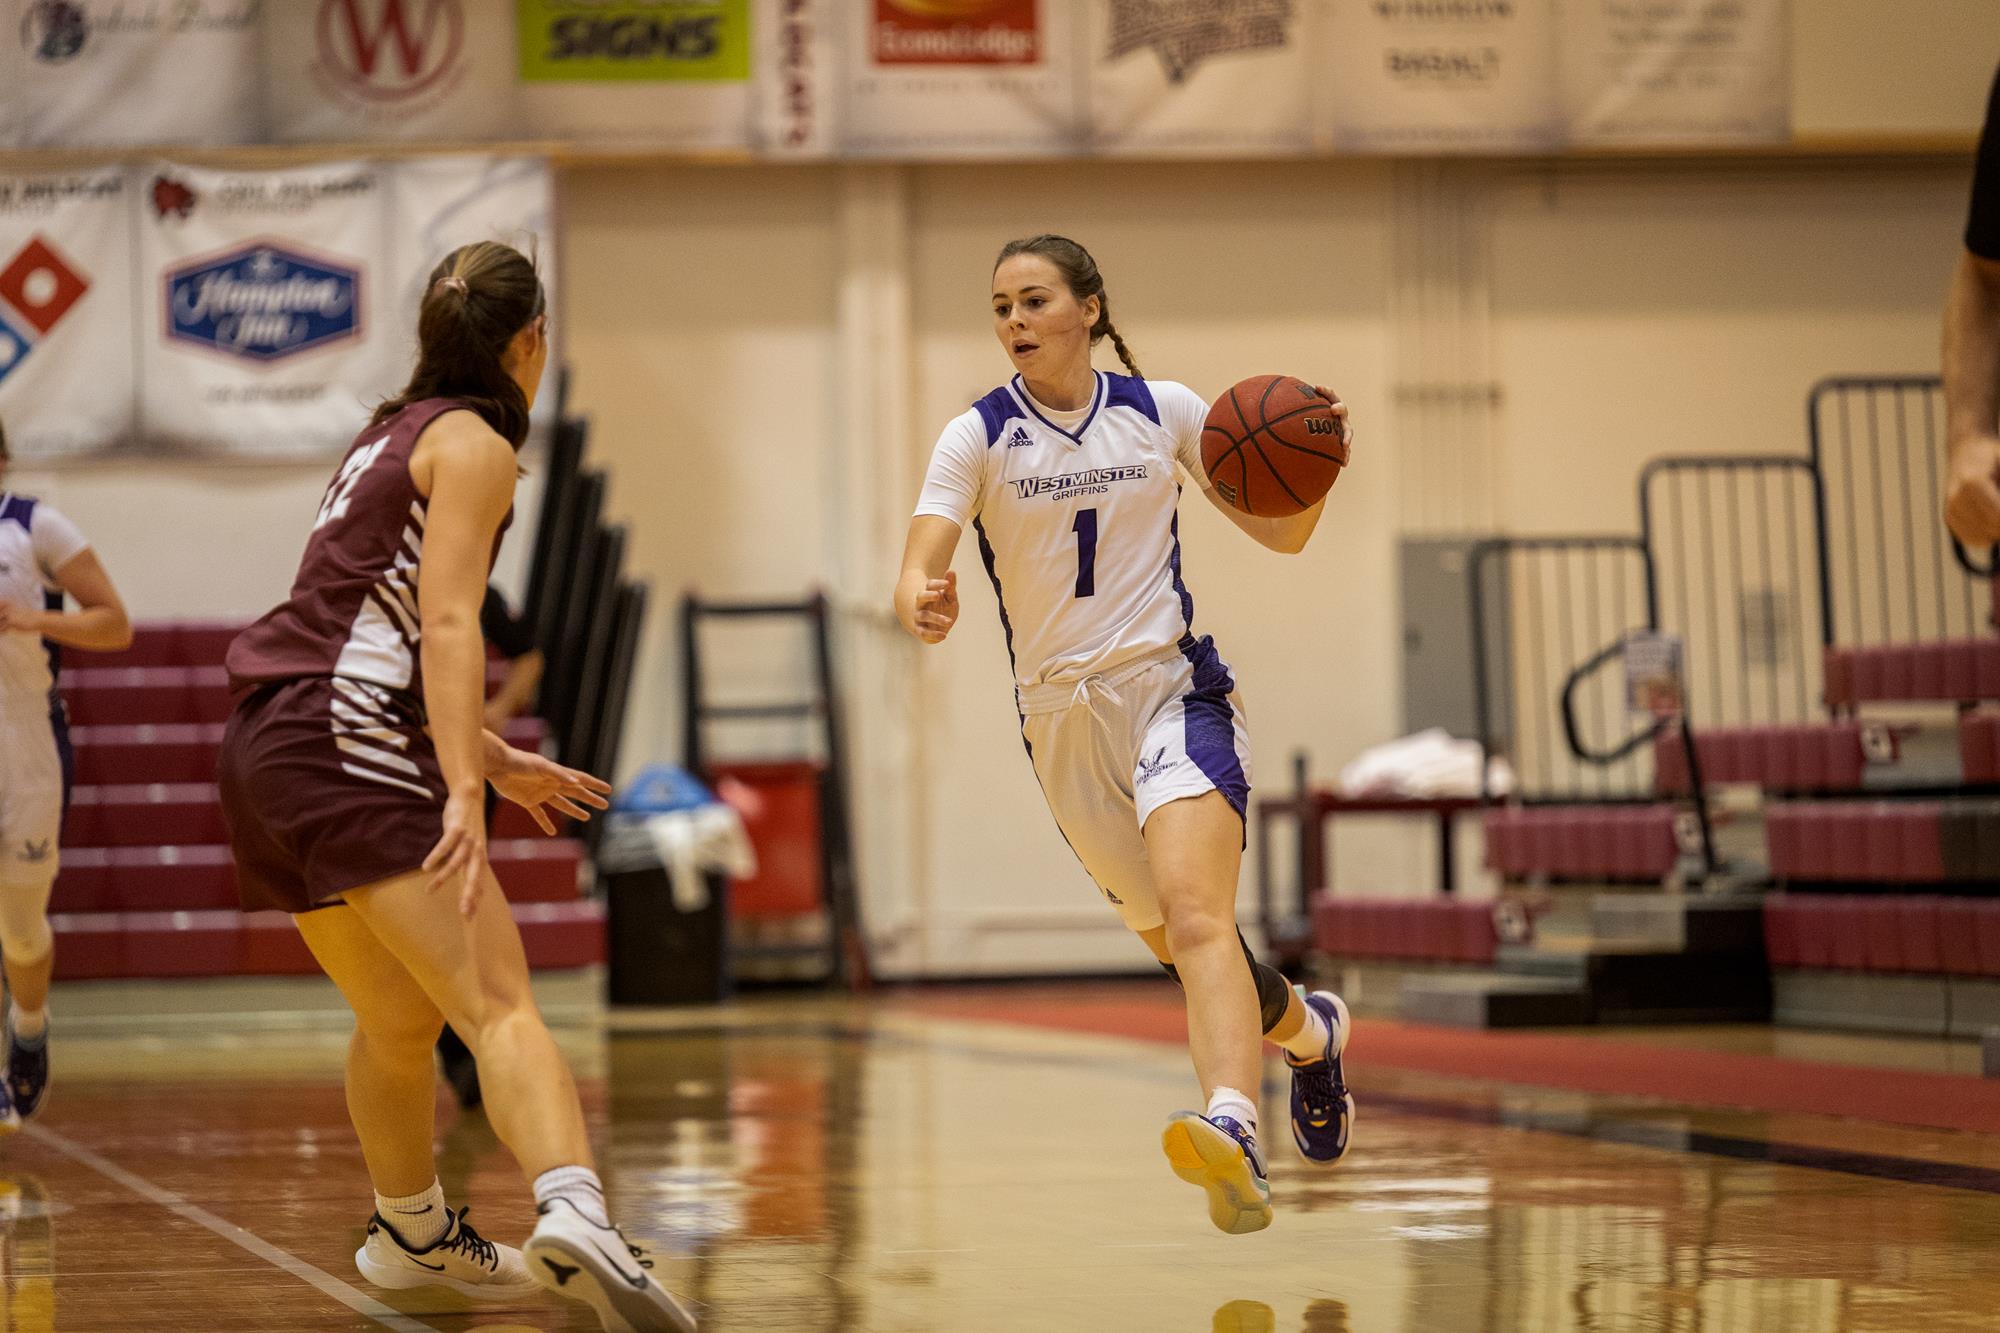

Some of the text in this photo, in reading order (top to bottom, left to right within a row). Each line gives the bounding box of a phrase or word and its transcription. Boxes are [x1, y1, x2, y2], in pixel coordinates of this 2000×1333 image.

[545, 15, 723, 60] SIGNS
[1008, 438, 1034, 449] adidas
[1008, 465, 1148, 499] WESTMINSTER
[1052, 484, 1109, 501] GRIFFINS
[1071, 508, 1098, 599] 1
